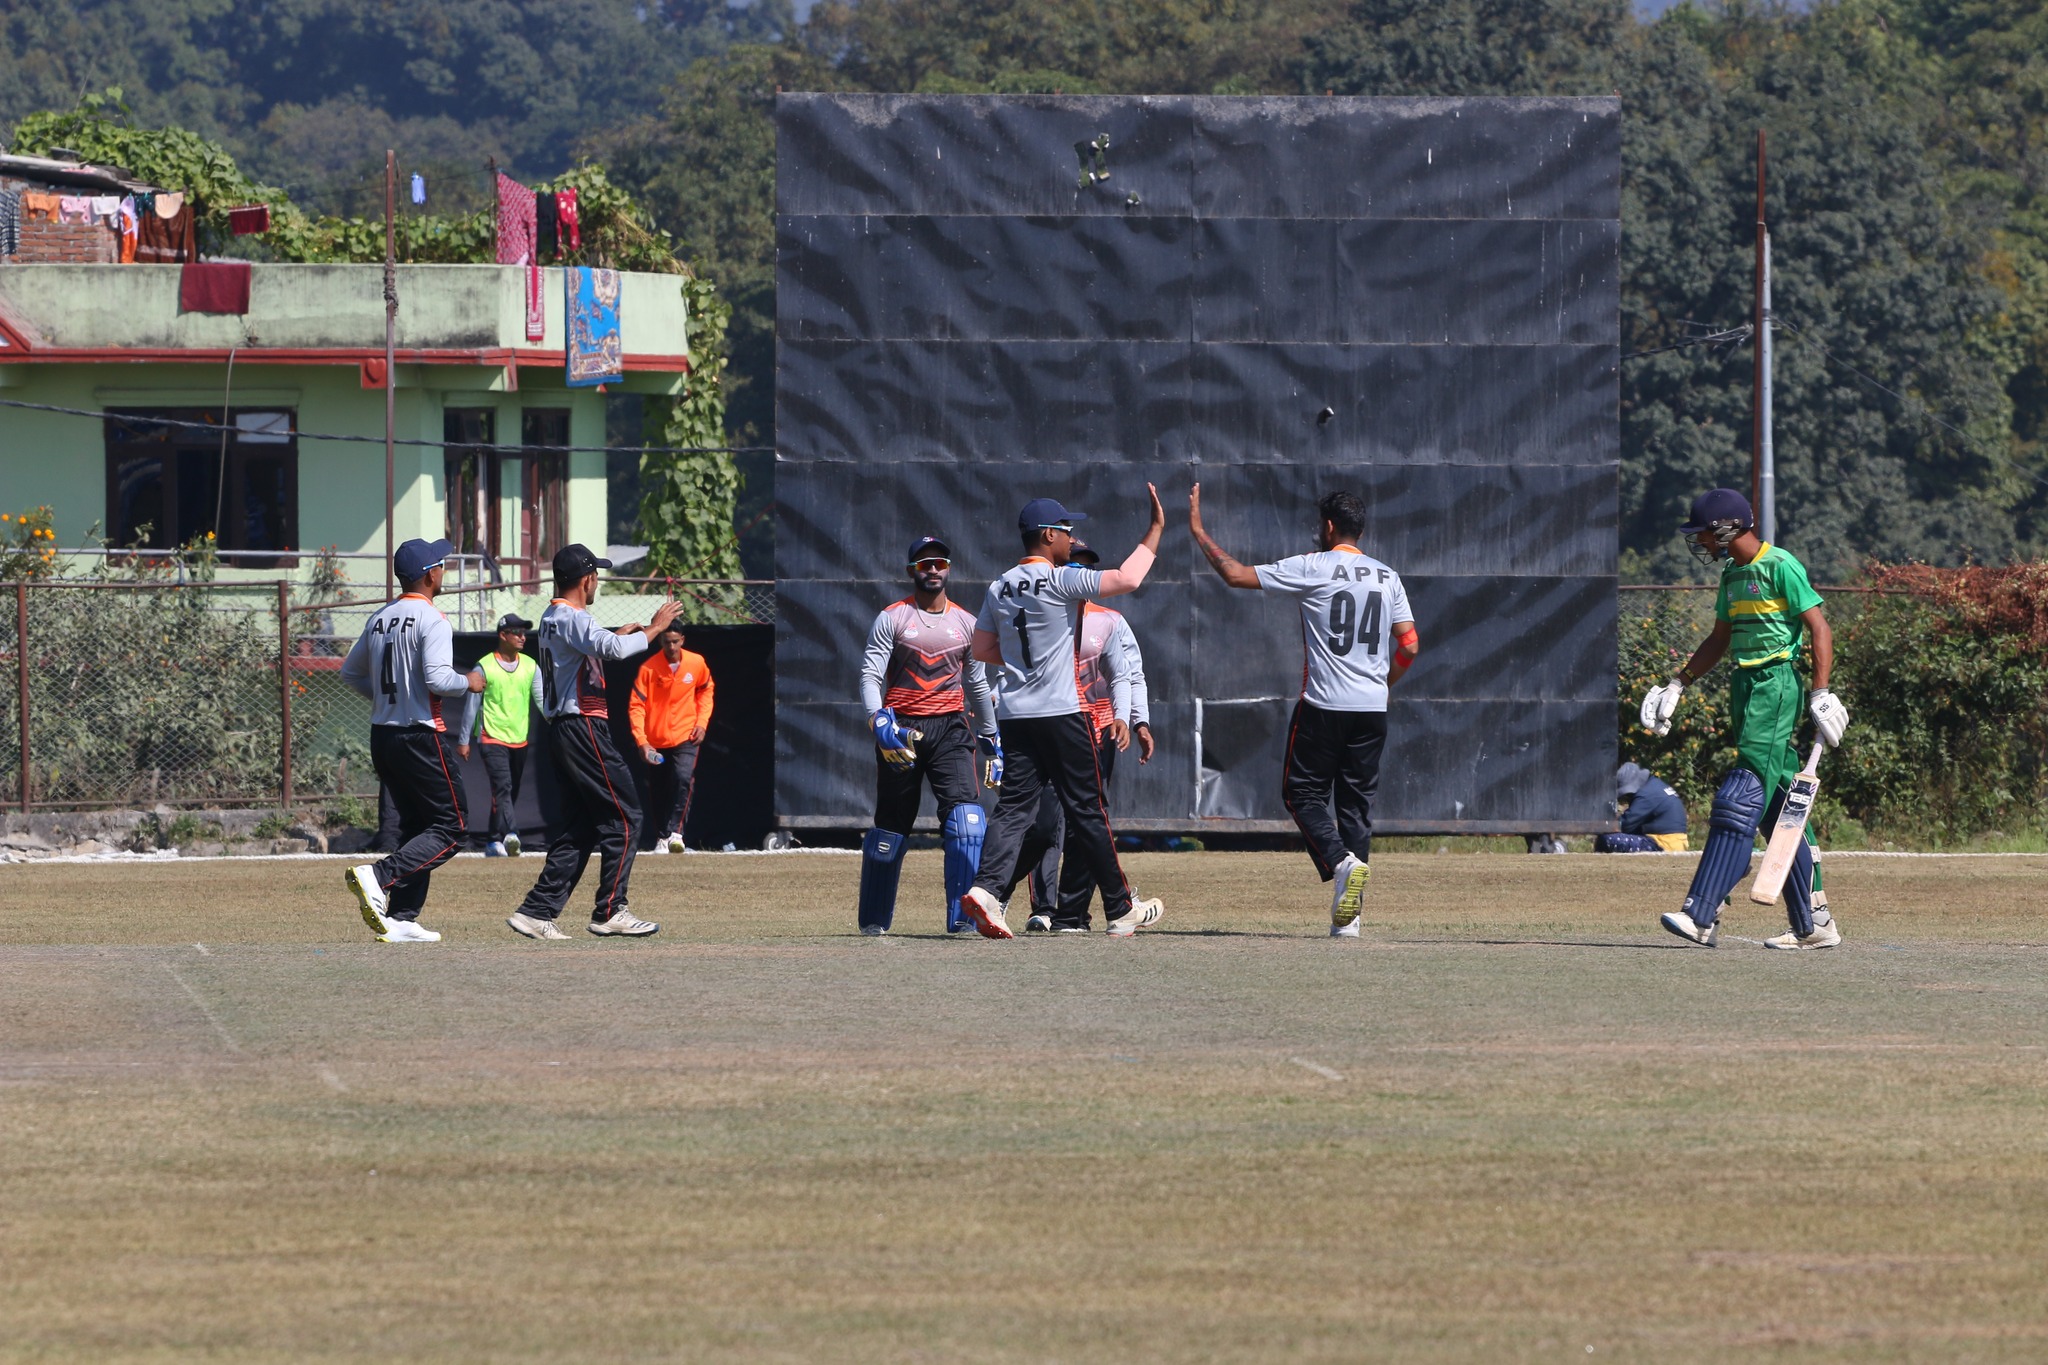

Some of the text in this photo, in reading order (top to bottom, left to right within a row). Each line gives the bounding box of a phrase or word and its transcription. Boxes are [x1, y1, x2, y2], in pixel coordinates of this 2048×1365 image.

[999, 578, 1048, 599] APF
[1331, 564, 1390, 584] APF
[371, 617, 416, 635] APF
[1012, 607, 1033, 669] 1
[1329, 590, 1382, 656] 94
[380, 642, 397, 704] 4
